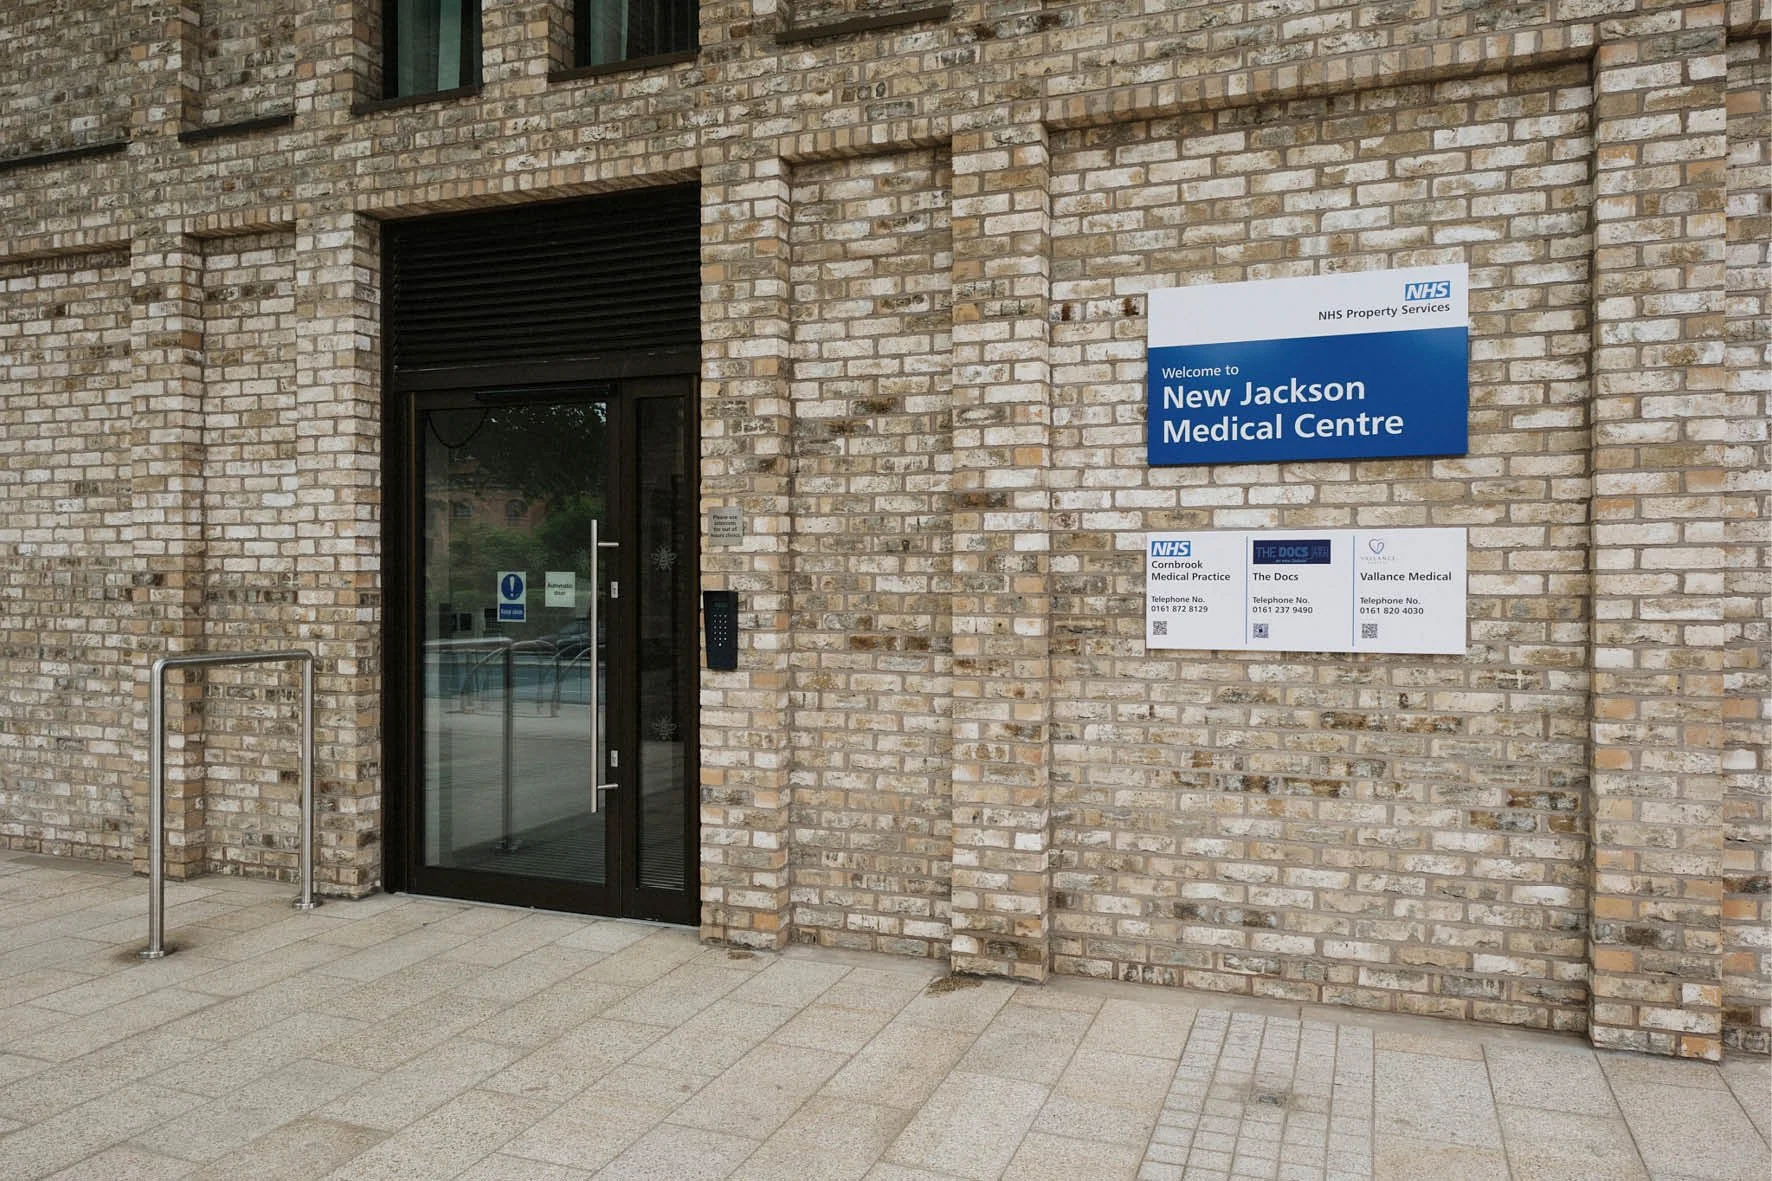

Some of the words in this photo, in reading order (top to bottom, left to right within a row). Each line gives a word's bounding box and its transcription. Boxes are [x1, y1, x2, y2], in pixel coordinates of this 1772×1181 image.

[1405, 281, 1449, 300] NHS
[1318, 310, 1343, 321] NHS
[1346, 306, 1398, 320] Property
[1401, 303, 1450, 316] Services
[1162, 366, 1221, 380] Welcome
[1225, 365, 1239, 377] to
[1162, 385, 1231, 410] New
[1240, 378, 1365, 407] Jackson
[1162, 413, 1283, 444] Medical
[1294, 411, 1404, 439] Centre
[1152, 541, 1190, 557] NHS
[1255, 546, 1277, 559] THE
[1278, 546, 1310, 558] DOCS
[1151, 560, 1203, 569] Cornbrook
[1151, 572, 1189, 581] Medical
[1192, 572, 1231, 581] Practice
[1252, 572, 1271, 581] The
[1274, 572, 1299, 581] Docs
[1360, 572, 1406, 581] Vallance
[1408, 571, 1452, 581] Medical
[1151, 596, 1190, 604] Telephone
[1252, 596, 1294, 604] Telephone
[1360, 597, 1404, 605] Telephone
[1406, 597, 1421, 605] No.
[1151, 605, 1170, 613] 0161
[1172, 605, 1187, 613] 872
[1189, 605, 1208, 613] 8129
[1252, 606, 1272, 614] 0161
[1275, 606, 1290, 614] 237
[1292, 606, 1313, 614] 9490
[1360, 607, 1380, 615] 0161
[1383, 607, 1400, 615] 820
[1402, 607, 1424, 615] 4030
